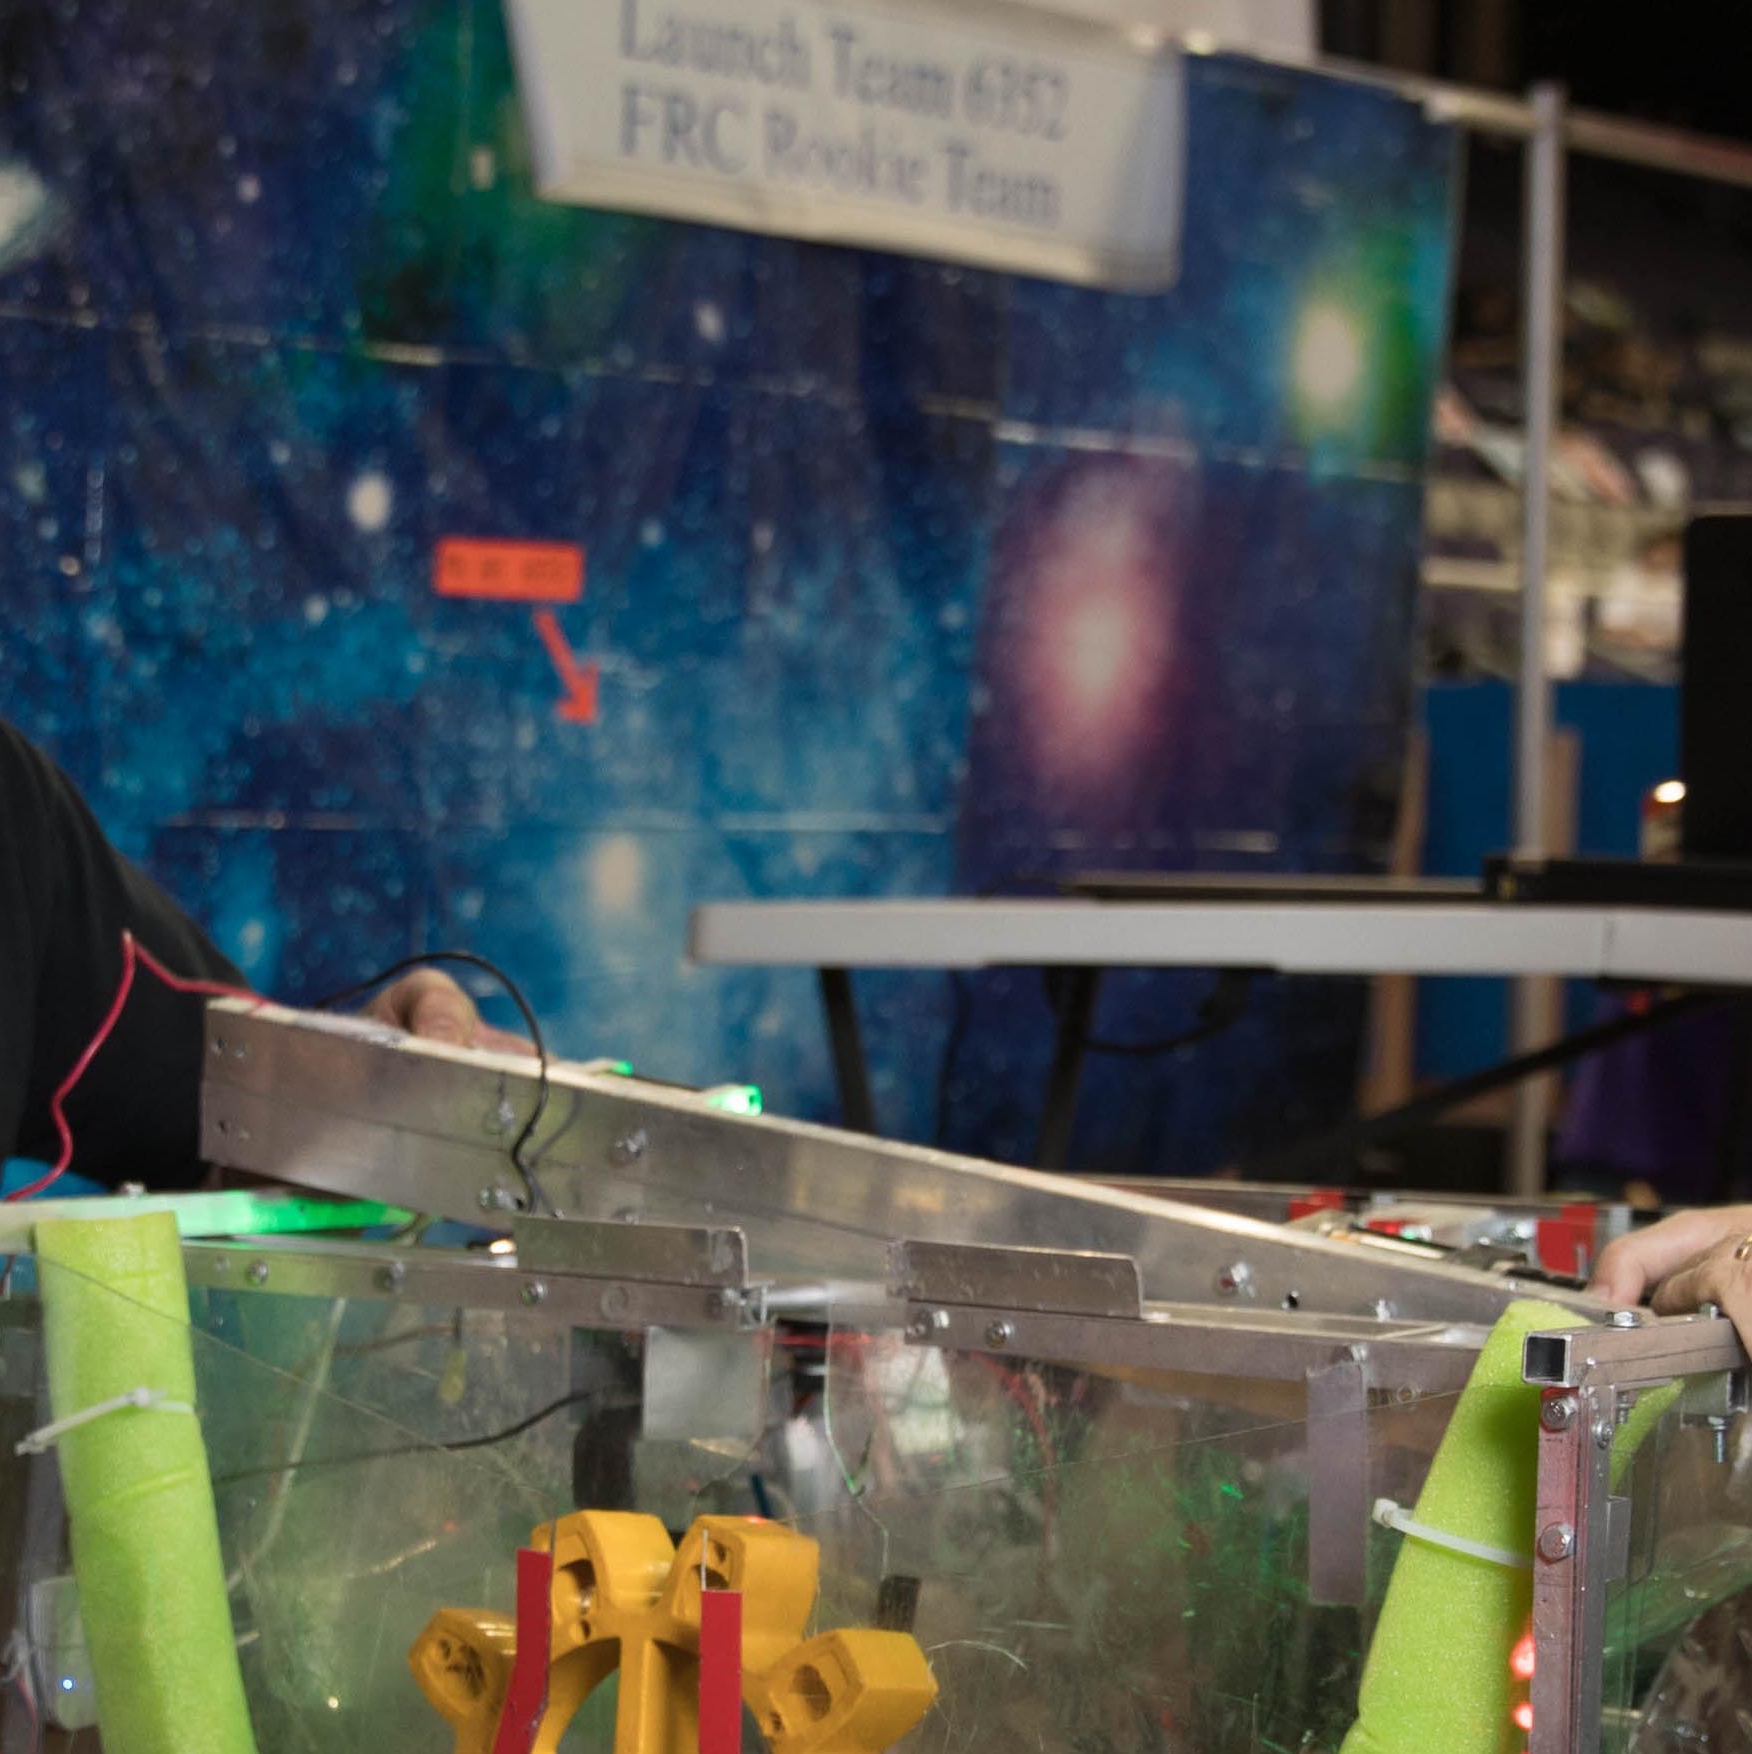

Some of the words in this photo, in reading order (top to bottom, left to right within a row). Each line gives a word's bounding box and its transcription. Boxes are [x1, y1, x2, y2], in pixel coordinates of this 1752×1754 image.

[827, 24, 953, 119] Team
[621, 81, 749, 175] FRC
[763, 106, 931, 206] Rookie
[939, 138, 1063, 230] Team
